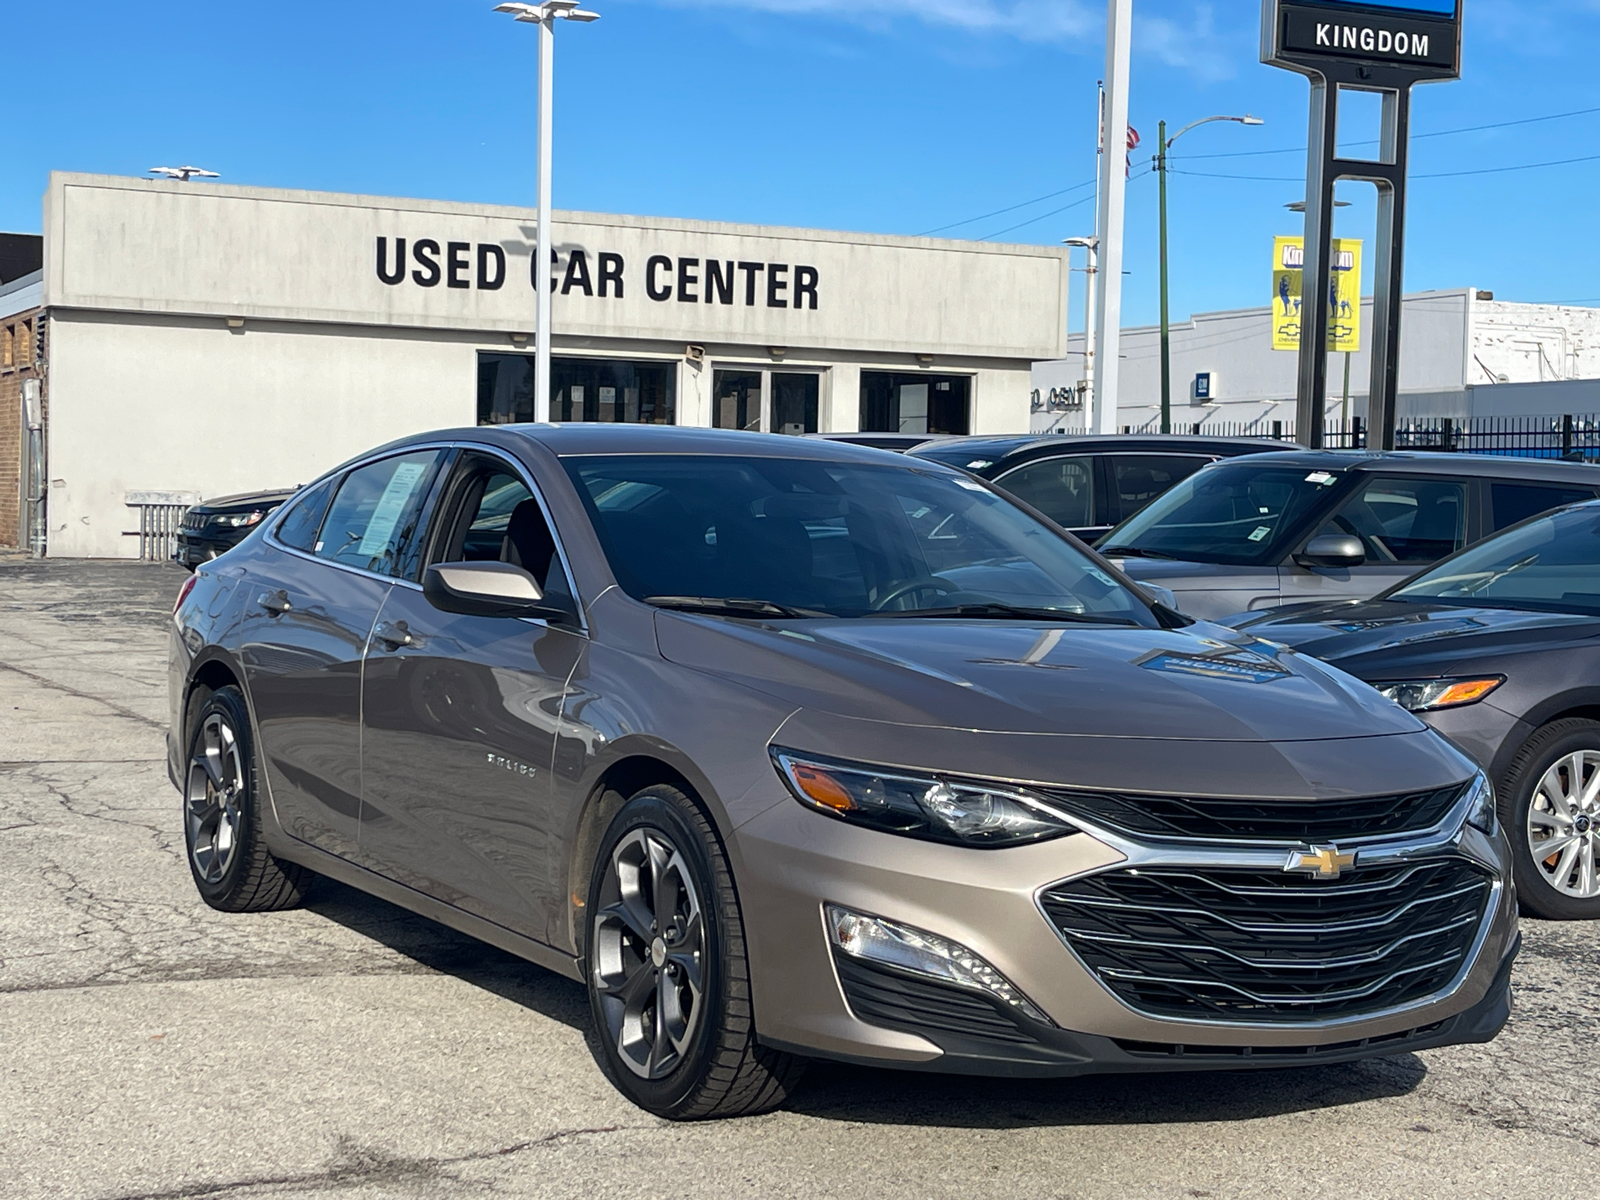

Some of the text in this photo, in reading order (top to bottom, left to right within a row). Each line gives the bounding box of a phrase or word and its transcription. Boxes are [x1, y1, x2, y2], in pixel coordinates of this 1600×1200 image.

[1316, 23, 1429, 57] KINGDOM
[376, 236, 506, 291] USED
[645, 254, 819, 310] CENTER
